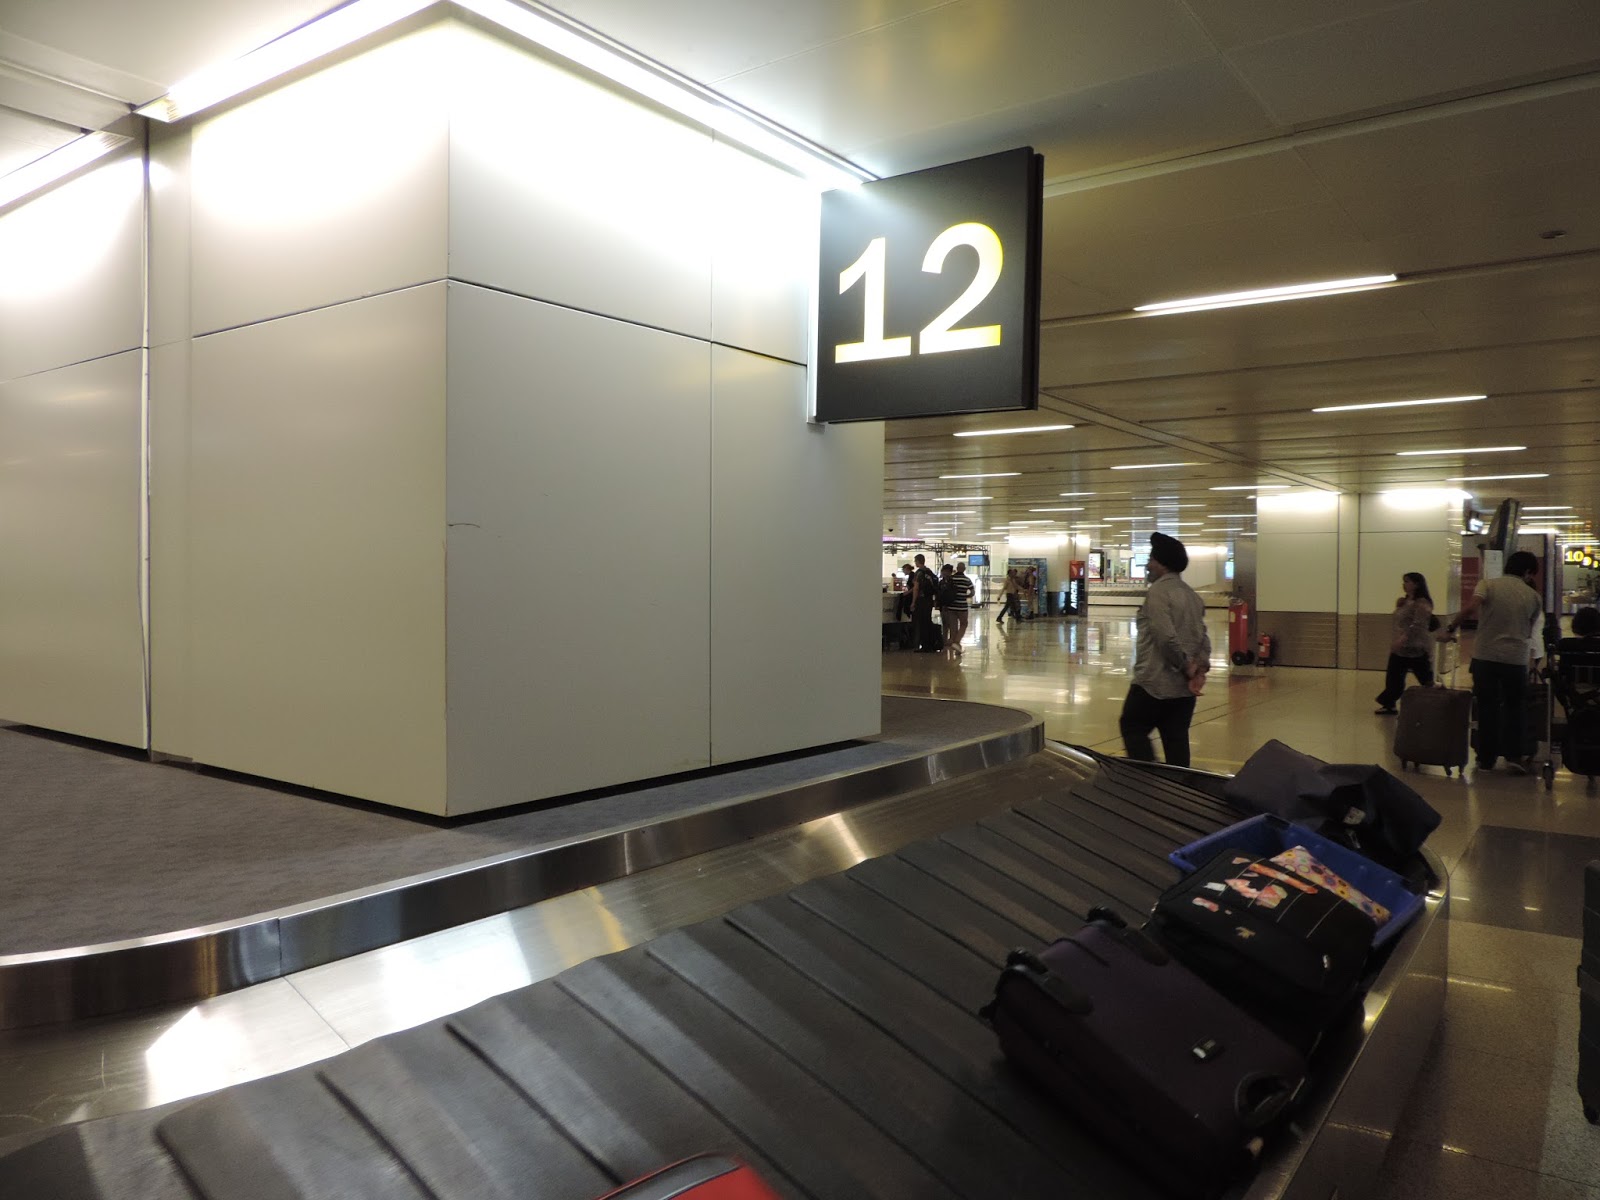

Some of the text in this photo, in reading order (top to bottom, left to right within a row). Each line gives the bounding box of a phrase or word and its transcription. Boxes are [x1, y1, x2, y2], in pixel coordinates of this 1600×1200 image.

[835, 222, 1003, 363] 12
[1565, 550, 1584, 562] 10
[1070, 580, 1078, 609] AIRCEL
